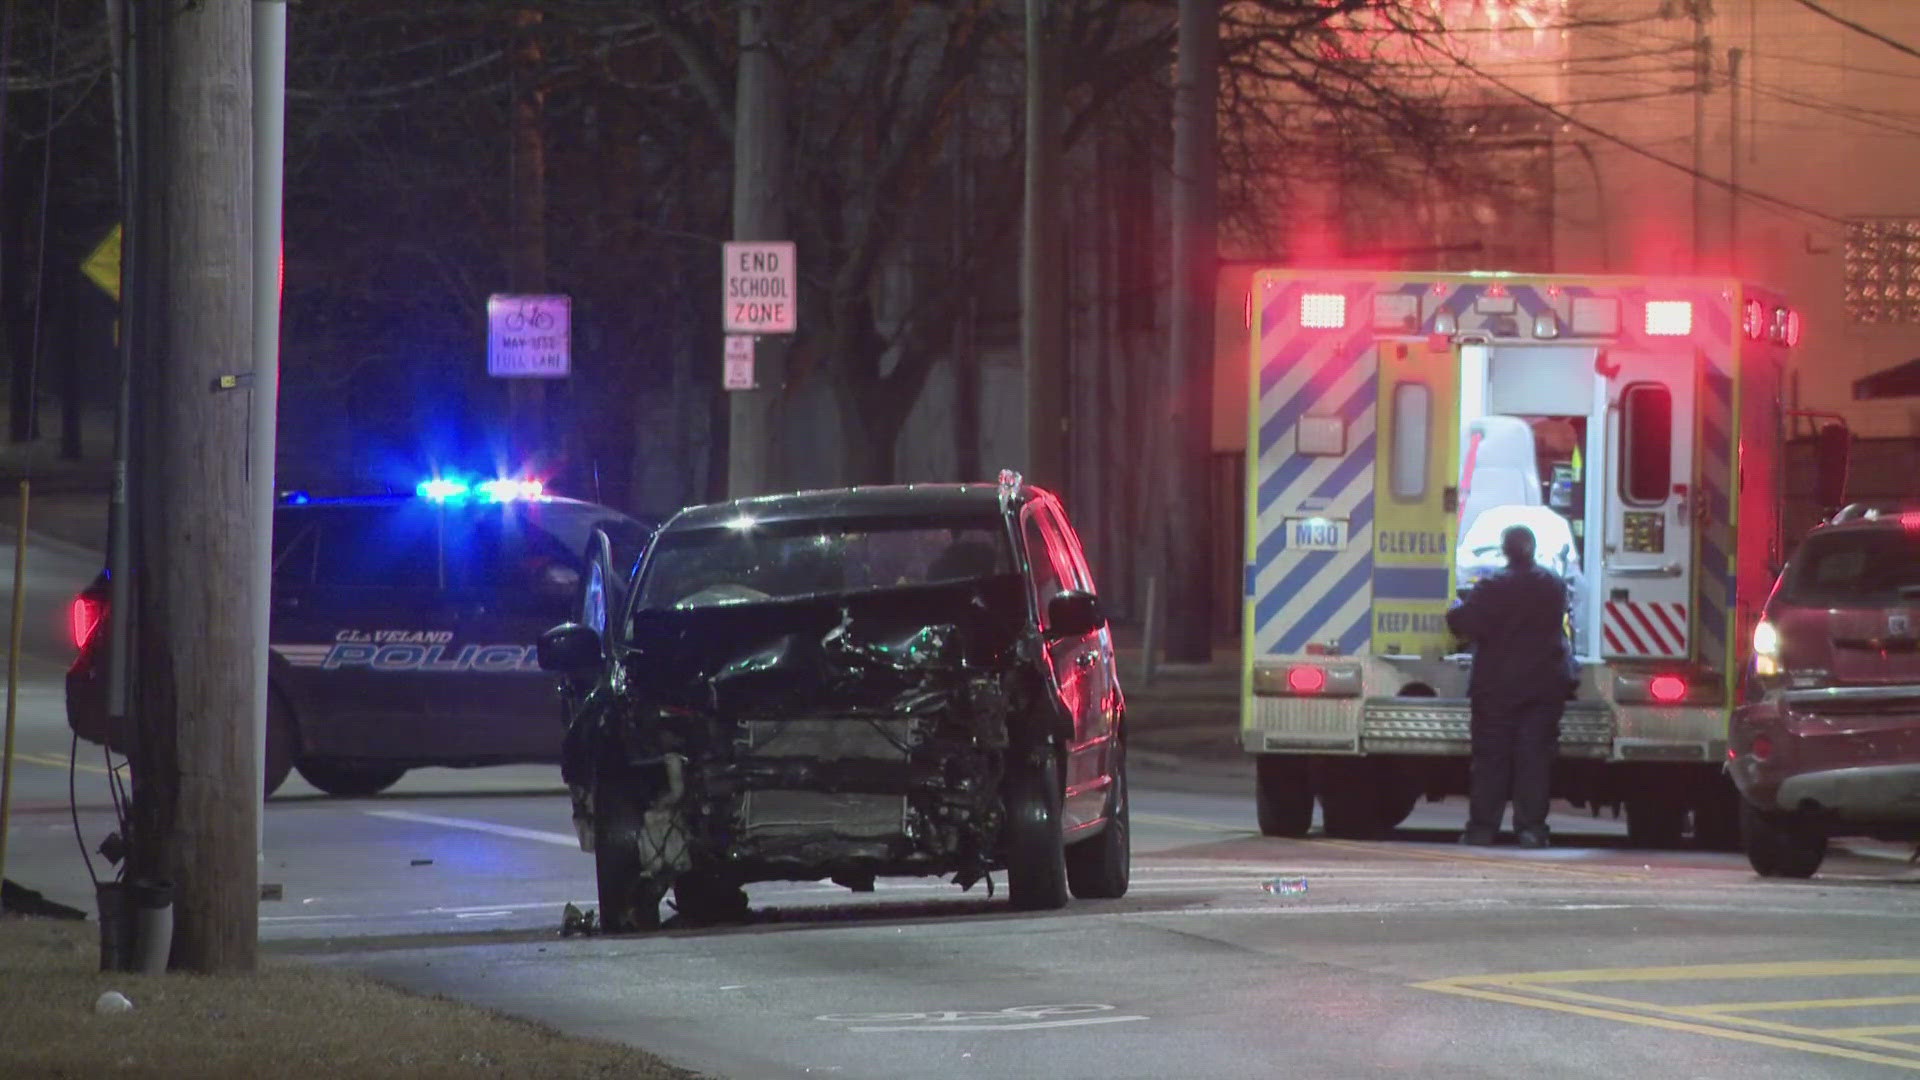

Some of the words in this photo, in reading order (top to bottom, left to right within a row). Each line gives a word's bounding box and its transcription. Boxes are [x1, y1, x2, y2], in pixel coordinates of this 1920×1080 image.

[741, 252, 779, 272] END
[730, 277, 788, 298] SCHOOL
[735, 303, 785, 322] ZONE
[1296, 525, 1339, 545] M30
[1378, 612, 1410, 633] KEEP
